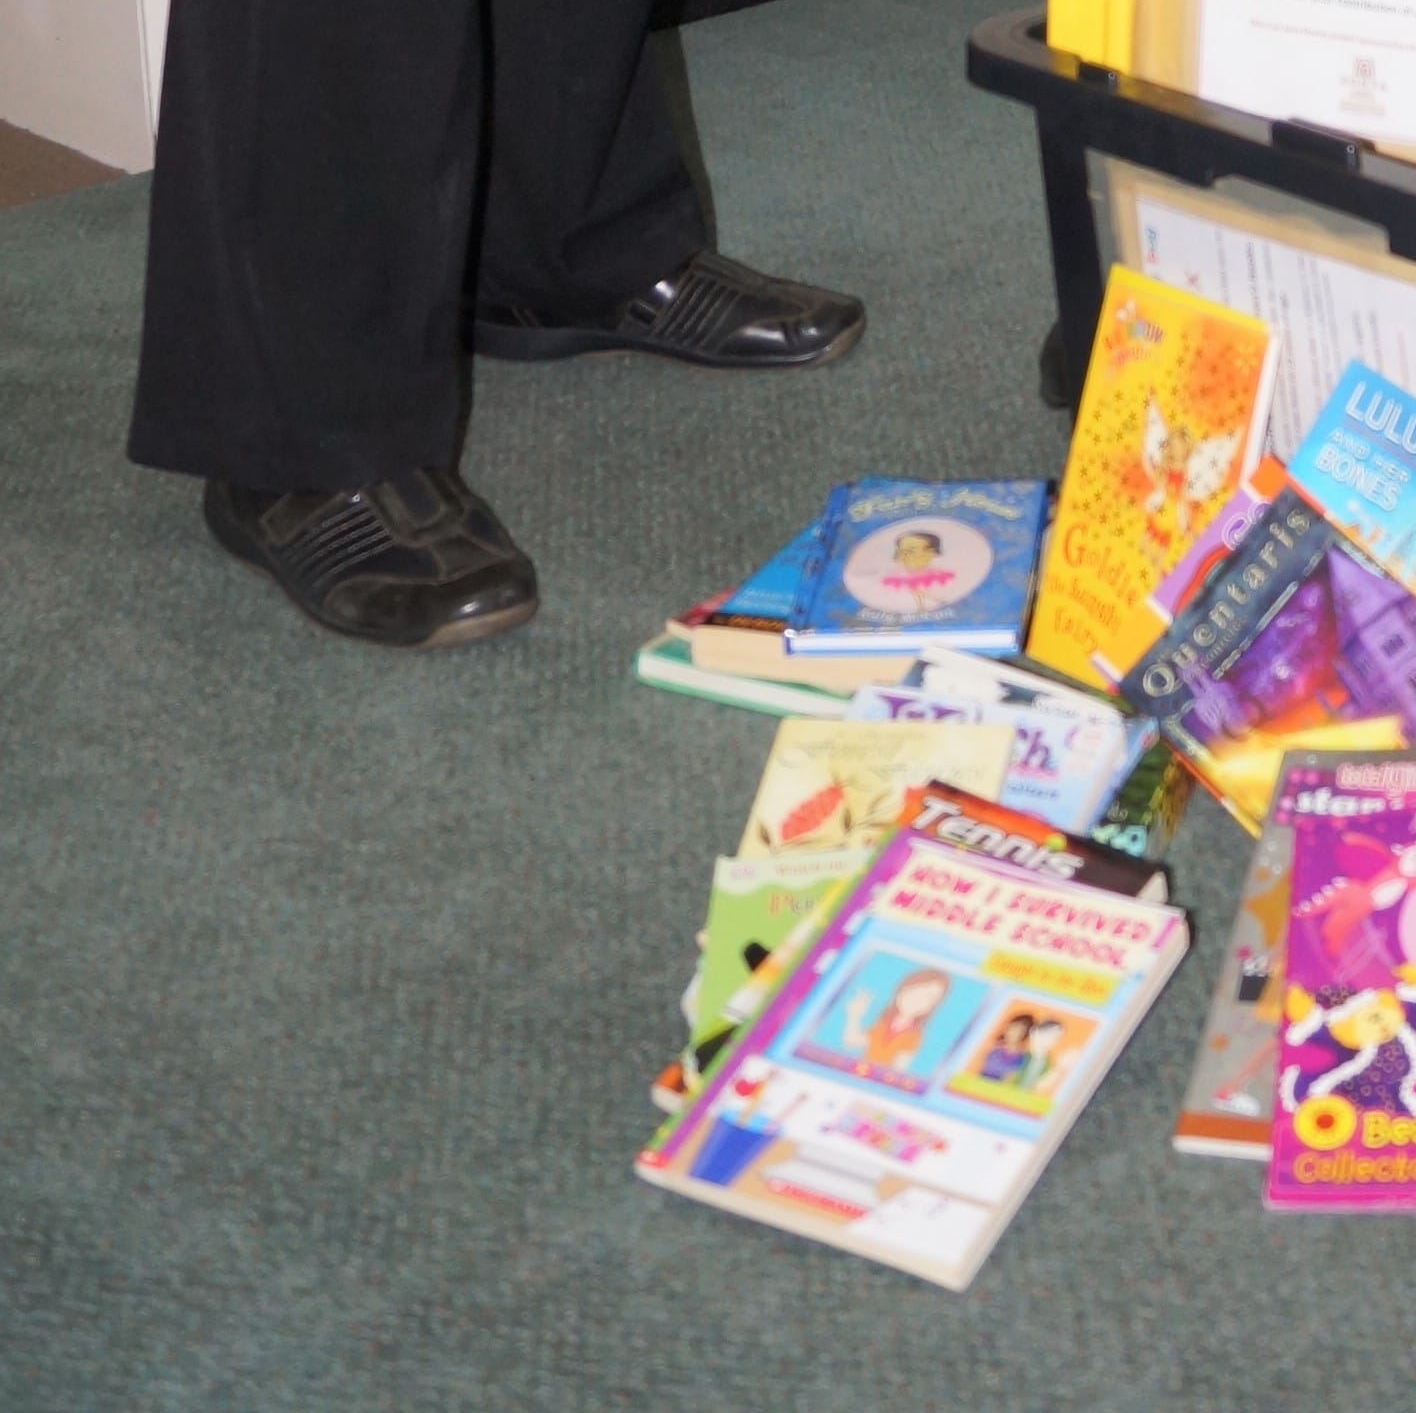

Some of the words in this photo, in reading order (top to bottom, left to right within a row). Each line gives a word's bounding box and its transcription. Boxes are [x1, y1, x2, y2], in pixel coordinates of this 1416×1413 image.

[1316, 442, 1399, 512] BONES
[1330, 427, 1370, 460] AND
[1143, 509, 1310, 697] Quentaris
[911, 796, 1085, 880] Tennis
[891, 890, 999, 935] MIDDLE
[1010, 924, 1127, 970] SCHOOL
[911, 867, 974, 895] HOW
[986, 886, 999, 903] I
[1007, 894, 1150, 942] SURVIVED
